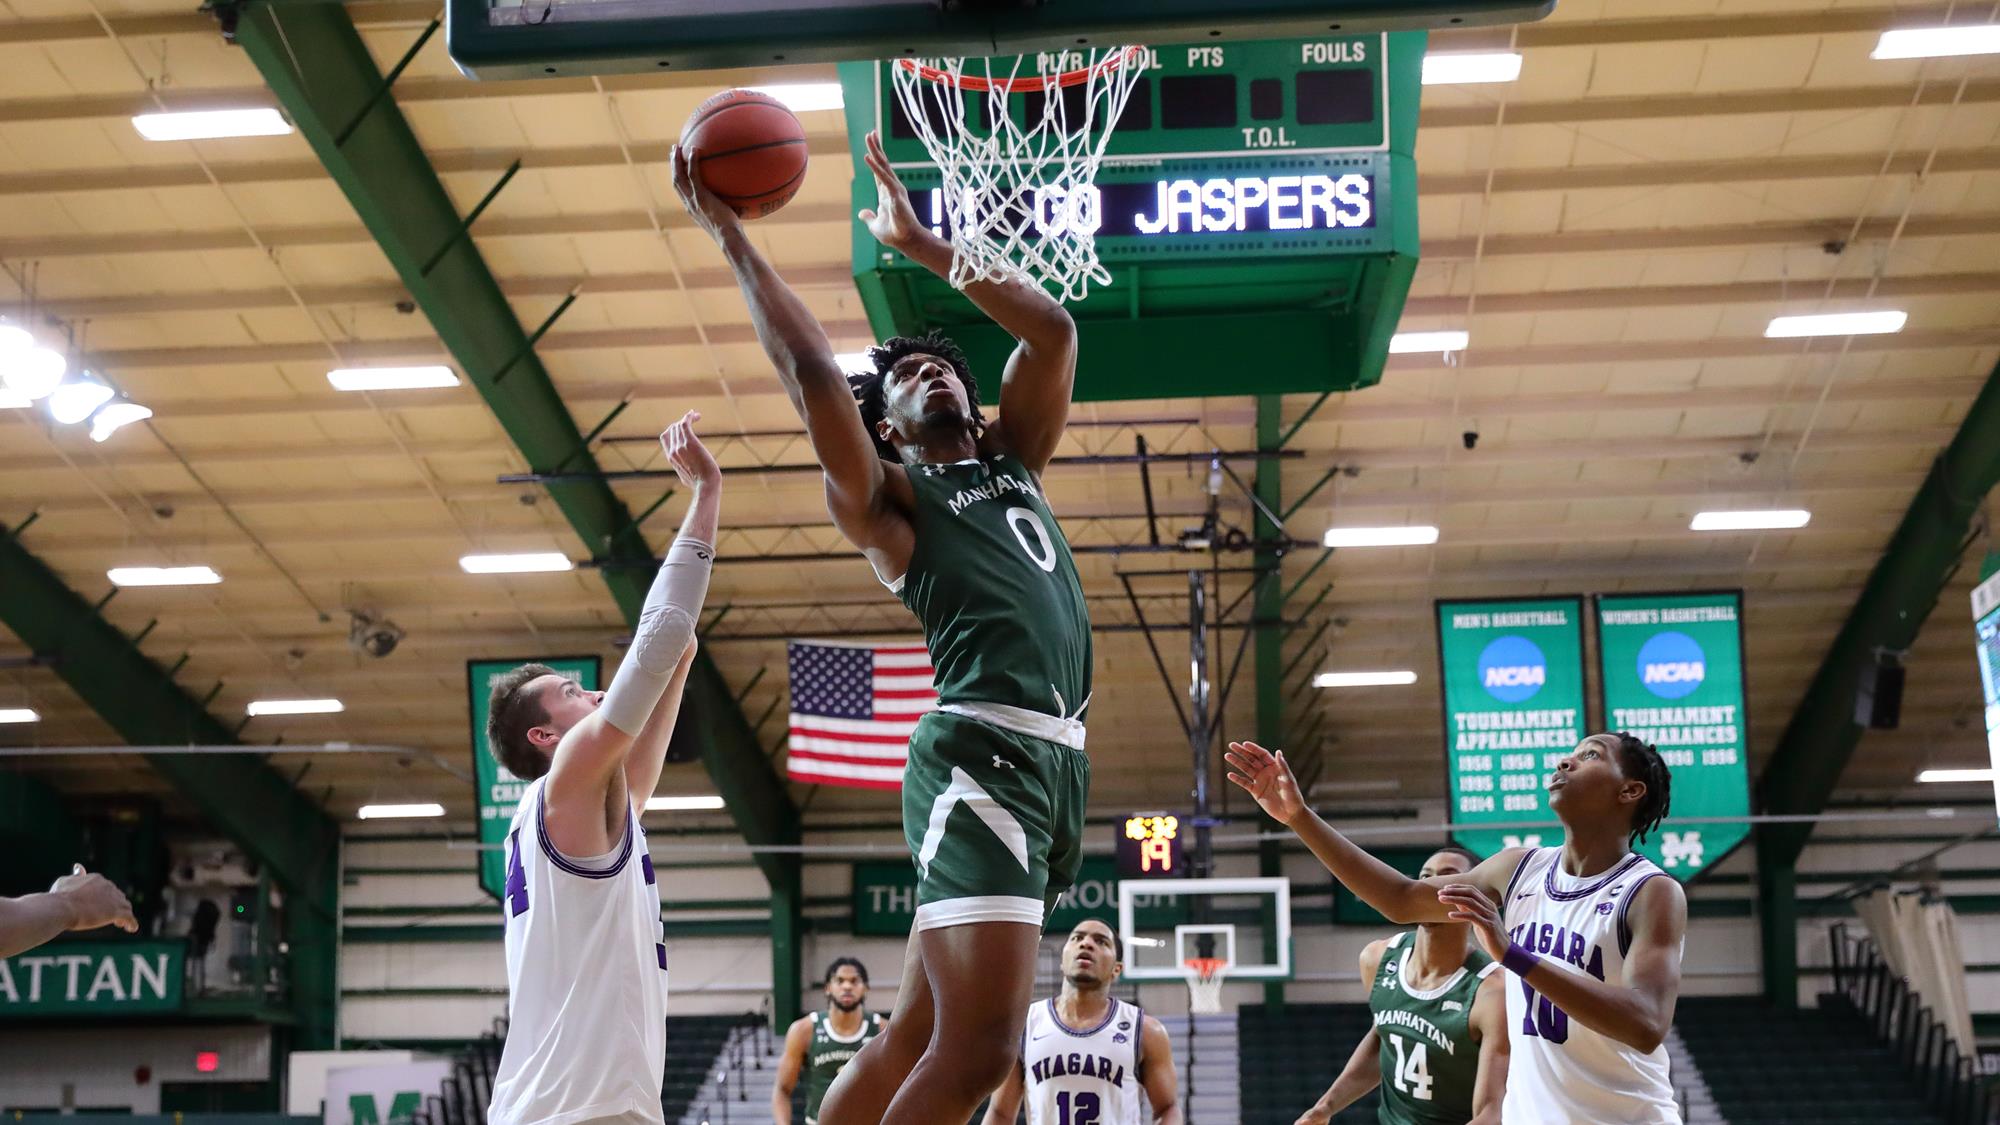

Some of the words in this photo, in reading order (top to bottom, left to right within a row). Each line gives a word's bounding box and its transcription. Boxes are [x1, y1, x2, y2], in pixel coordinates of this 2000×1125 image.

[1187, 47, 1224, 68] PTS
[1302, 42, 1365, 64] FOULS
[1242, 127, 1296, 148] T.O.L.
[1135, 174, 1370, 235] JASPERS
[1006, 507, 1057, 573] 0
[1492, 610, 1567, 627] BASKETBALL
[1661, 606, 1736, 624] BASKETBALL
[1485, 665, 1545, 688] NCAA
[1644, 661, 1705, 684] NCAA
[1455, 709, 1577, 731] TOURNAMENT
[1613, 705, 1736, 727] TOURNAMENT
[1456, 728, 1578, 750] APPEARANCES
[1374, 1010, 1455, 1056] MANHATTAN
[1032, 1053, 1124, 1089] NIAGARA
[1389, 1033, 1434, 1101] 14
[1056, 1091, 1100, 1125] 12
